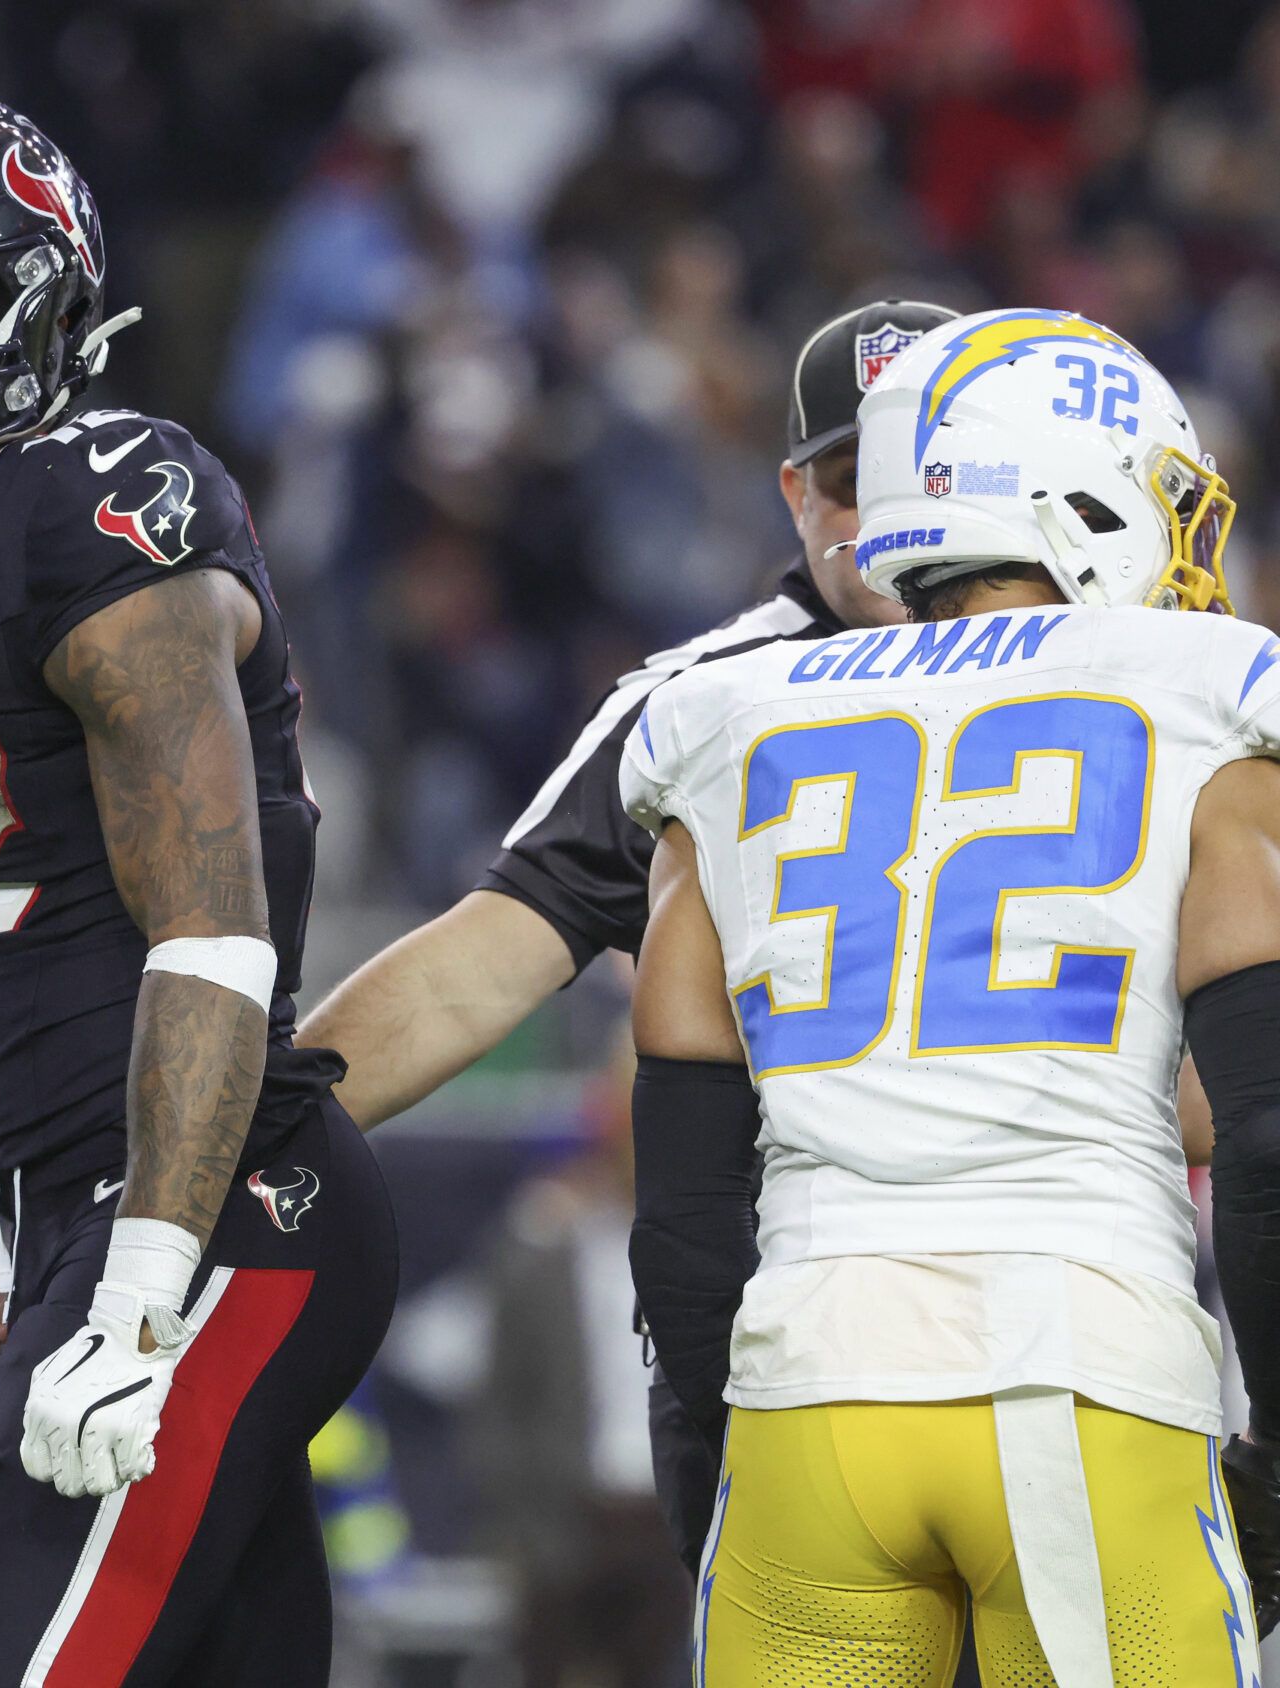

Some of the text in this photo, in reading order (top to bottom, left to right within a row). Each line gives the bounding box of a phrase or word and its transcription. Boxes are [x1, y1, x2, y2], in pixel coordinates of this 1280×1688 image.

[1052, 354, 1140, 436] 32
[787, 613, 1071, 685] GILMAN
[730, 690, 1156, 1083] 32
